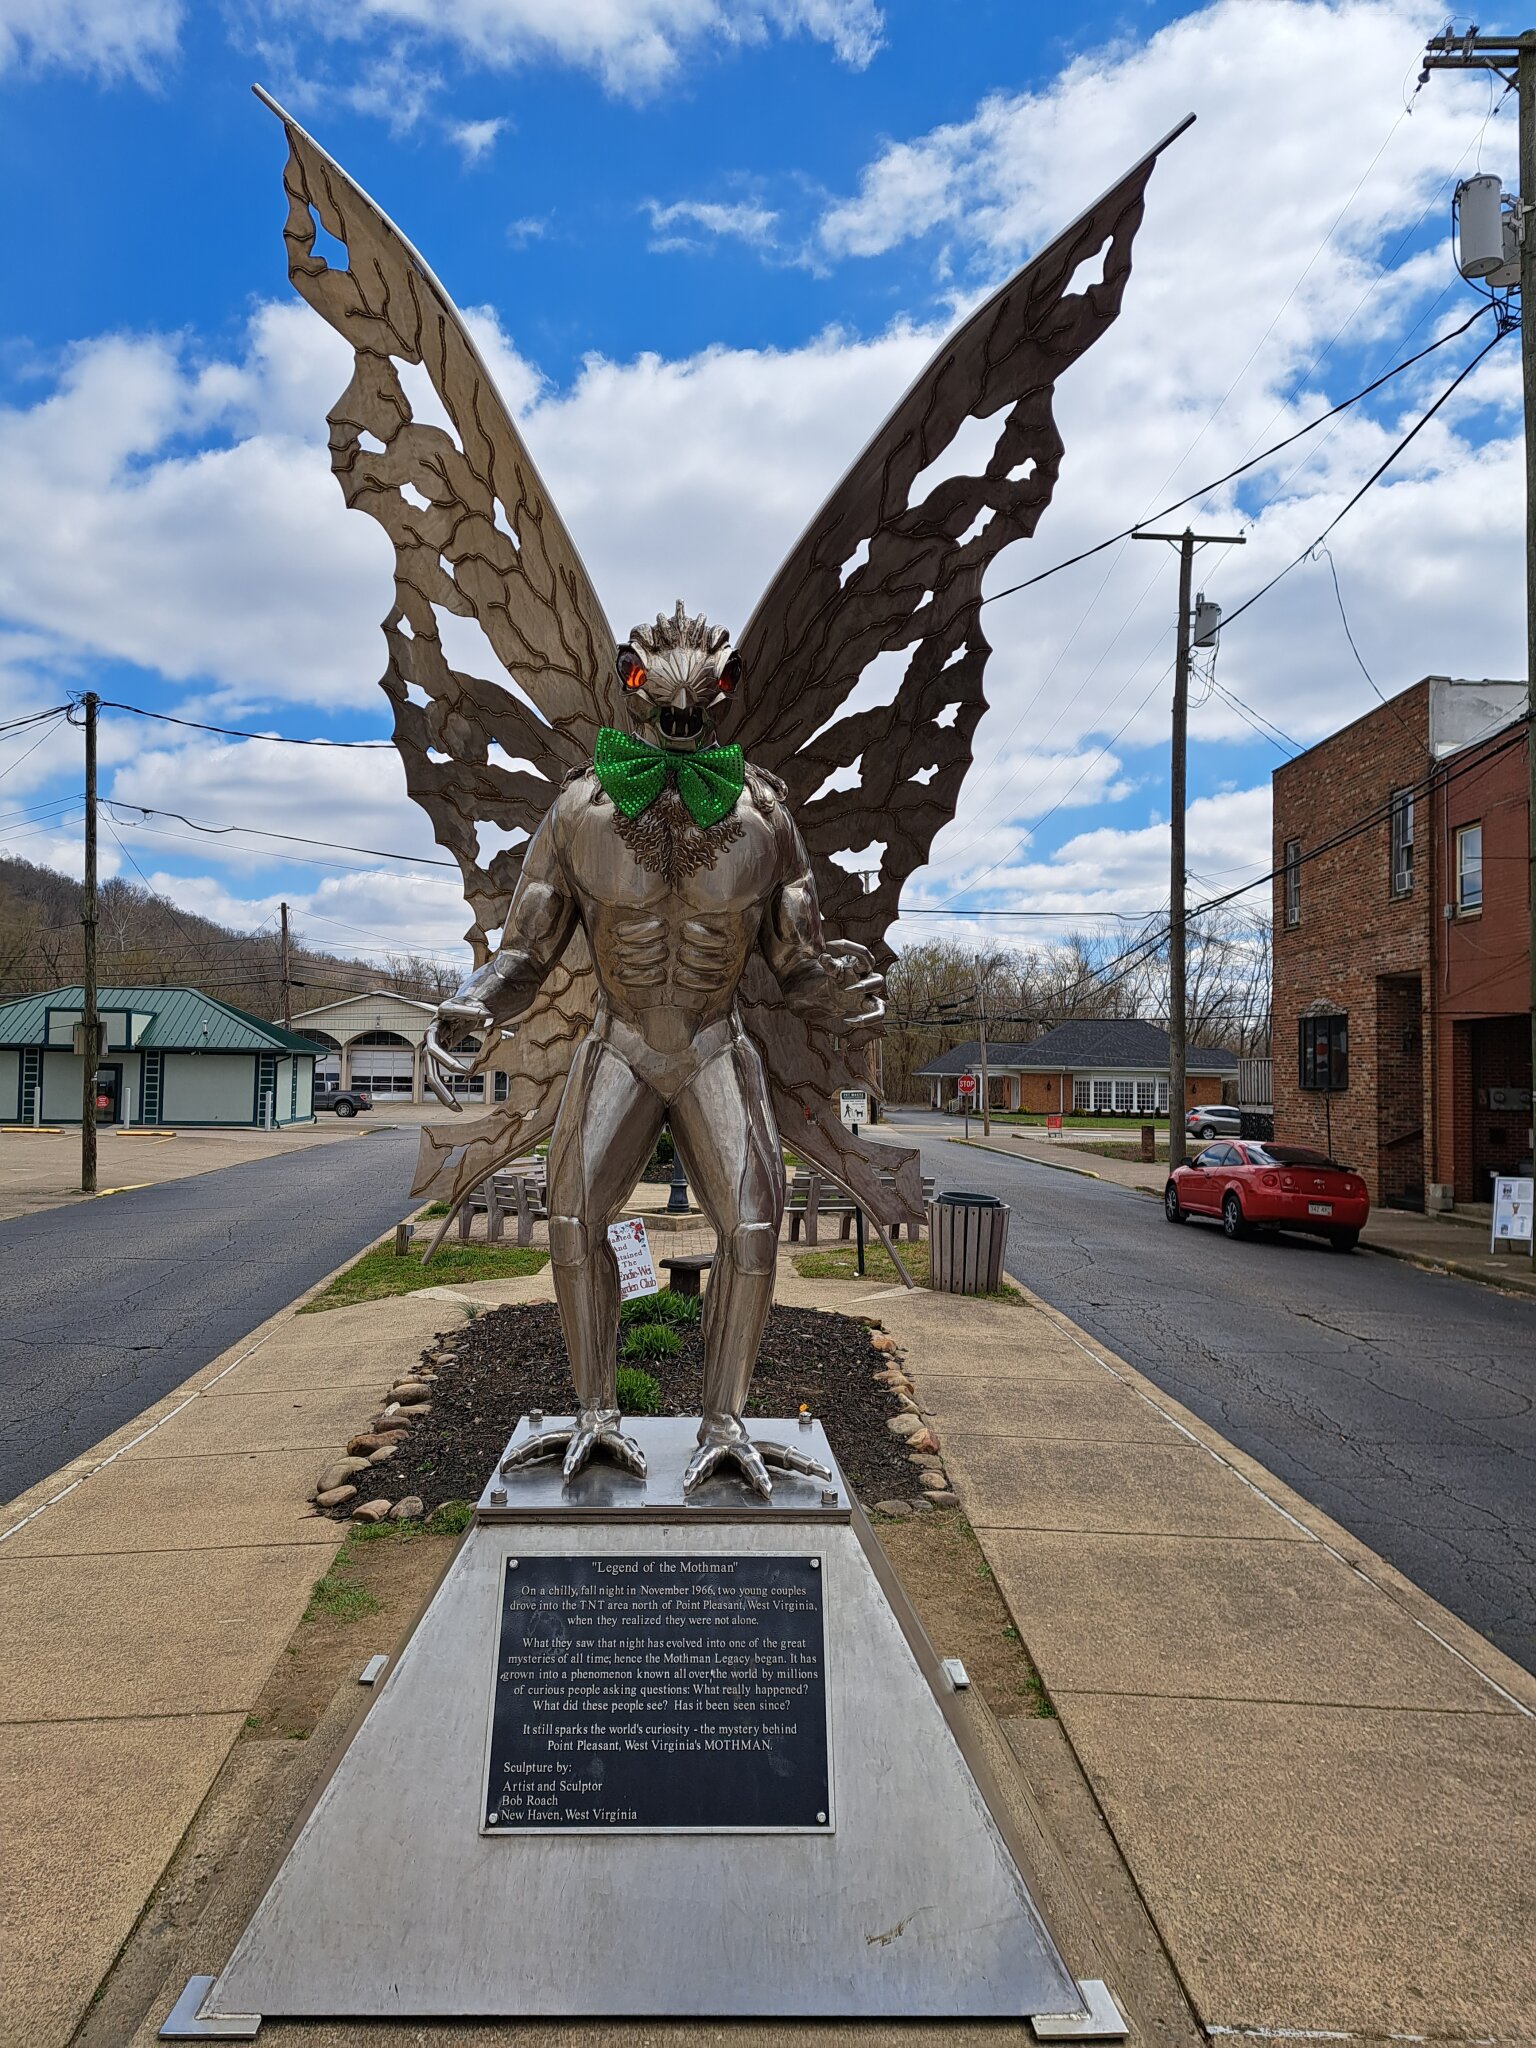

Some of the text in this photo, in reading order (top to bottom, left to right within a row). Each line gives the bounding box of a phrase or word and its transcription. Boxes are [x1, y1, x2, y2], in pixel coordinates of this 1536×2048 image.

[959, 1080, 975, 1088] STOP
[622, 1260, 637, 1268] The
[640, 1277, 656, 1289] Club
[592, 1562, 738, 1575] "Legend of the Mothman"
[521, 1584, 807, 1598] On a chilly, fall night in November 1966, two young couples
[509, 1600, 536, 1610] drove
[539, 1600, 558, 1610] into
[562, 1600, 577, 1610] the
[580, 1600, 605, 1610] TNT
[632, 1600, 658, 1609] north
[662, 1600, 673, 1609] of
[675, 1600, 700, 1609] Point
[703, 1600, 746, 1611] Pleasant,
[747, 1600, 770, 1609] West
[773, 1600, 817, 1612] Virginia,
[567, 1615, 593, 1625] when
[597, 1615, 617, 1627] they
[621, 1615, 661, 1624] realized
[665, 1615, 686, 1627] they
[714, 1616, 729, 1624] not
[731, 1615, 759, 1624] alone.
[522, 1638, 549, 1648] What
[551, 1637, 572, 1650] they
[598, 1638, 617, 1647] that
[619, 1637, 645, 1650] night
[647, 1638, 664, 1648] has
[666, 1638, 703, 1647] evolved
[706, 1638, 726, 1648] into
[749, 1638, 759, 1647] of
[762, 1637, 778, 1648] the
[780, 1640, 806, 1650] great
[508, 1652, 817, 1666] mysteries of all time; hence the Mothman Legacy began. It has
[503, 1672, 535, 1681] grown
[539, 1669, 558, 1679] into
[570, 1669, 632, 1681] phenomenon
[637, 1668, 670, 1678] known
[674, 1668, 687, 1678] all
[711, 1668, 727, 1678] the
[731, 1668, 758, 1679] world
[762, 1669, 773, 1681] by
[777, 1668, 818, 1678] millions
[513, 1684, 808, 1697] of curious people asking questions: What really happened?
[533, 1700, 560, 1710] What
[563, 1700, 578, 1710] did
[582, 1700, 608, 1710] these
[611, 1700, 644, 1713] people
[646, 1700, 668, 1710] see?
[674, 1700, 693, 1710] Has
[696, 1699, 702, 1710] it
[706, 1700, 729, 1710] been
[759, 1700, 791, 1710] since?
[523, 1724, 530, 1734] It
[532, 1723, 553, 1734] still
[555, 1723, 588, 1737] sparks
[590, 1723, 606, 1734] the
[609, 1723, 643, 1734] world's
[645, 1723, 690, 1736] curiosity
[700, 1723, 715, 1734] the
[719, 1725, 759, 1736] mystery
[762, 1723, 797, 1735] behind
[547, 1739, 773, 1753] Point Pleasant, West Virginia's MOTHMAN.
[503, 1761, 572, 1775] Sculpture by:
[503, 1780, 603, 1794] Artist and Sculptor
[502, 1794, 558, 1805] Bob Roach
[501, 1808, 637, 1822] New Haven, West Virginia
